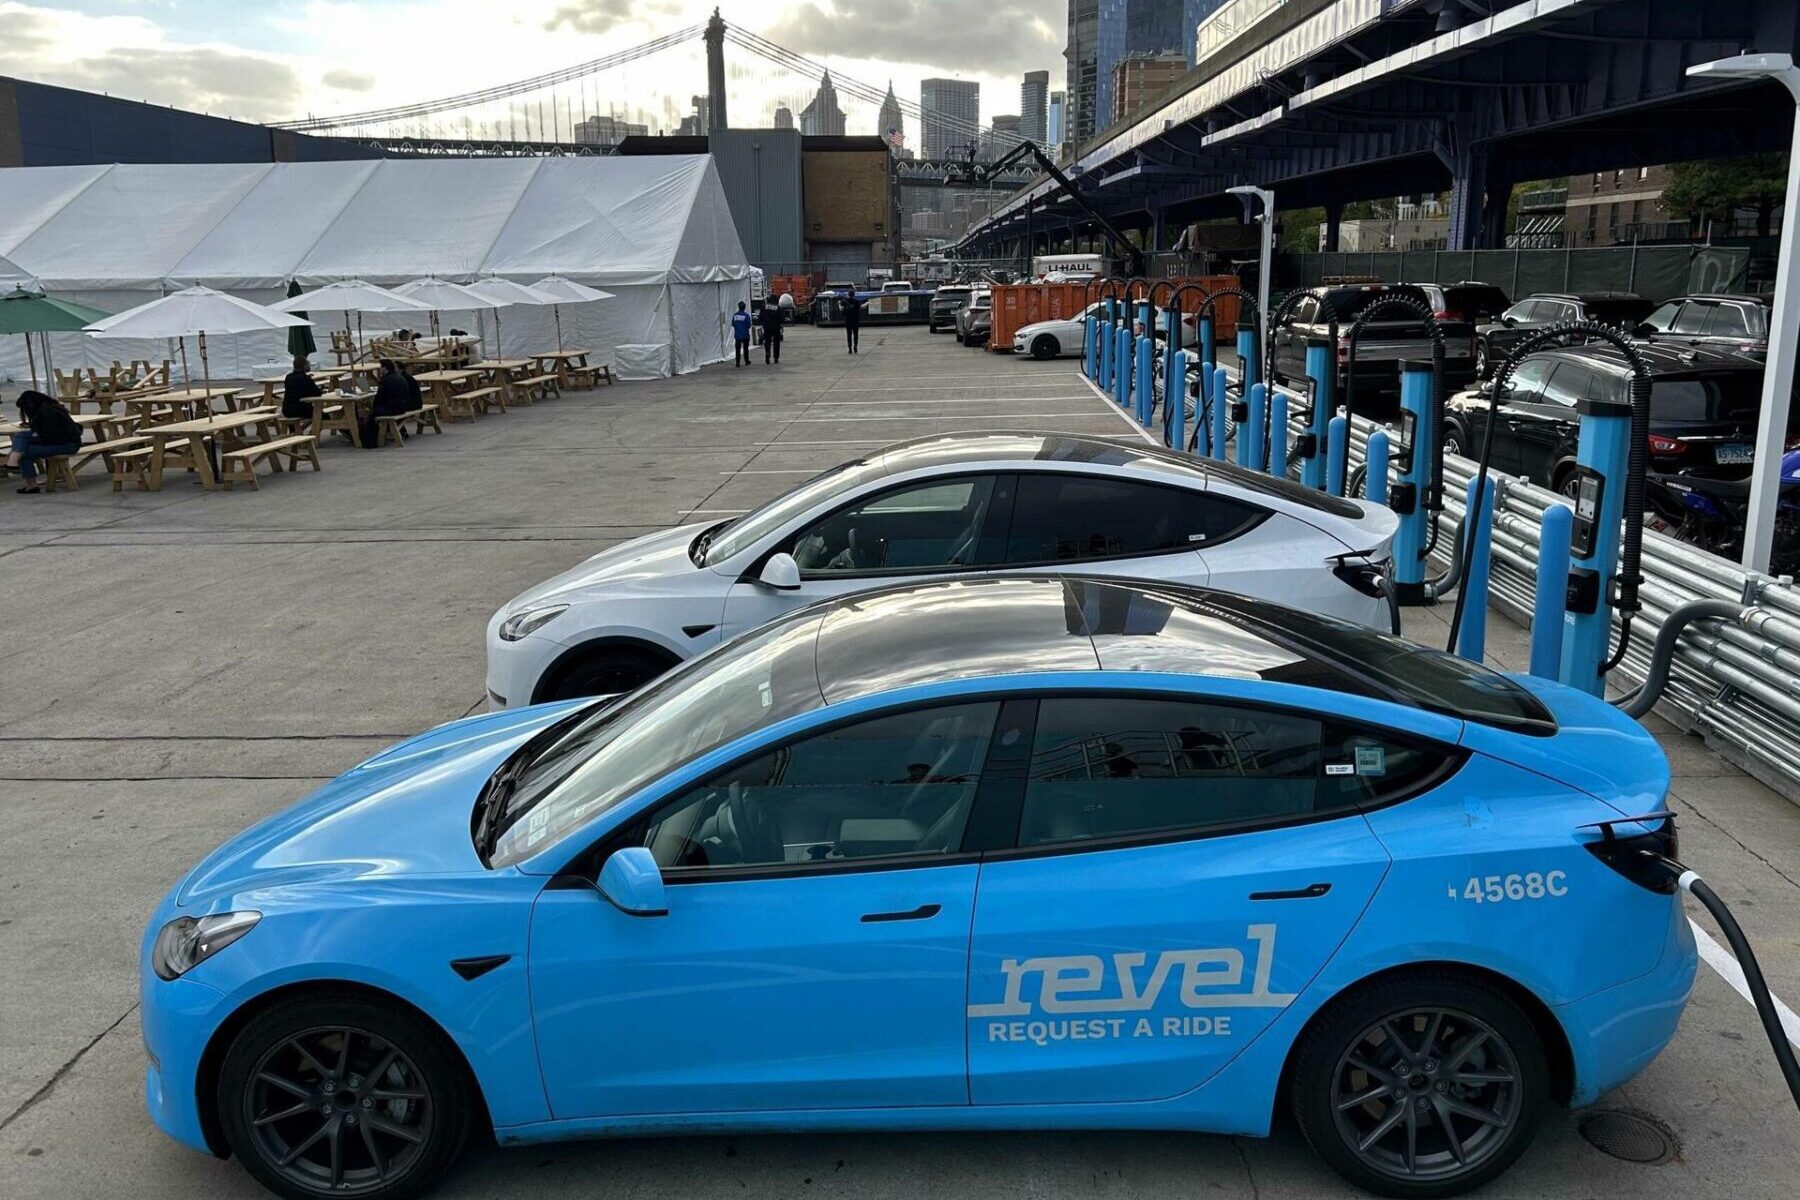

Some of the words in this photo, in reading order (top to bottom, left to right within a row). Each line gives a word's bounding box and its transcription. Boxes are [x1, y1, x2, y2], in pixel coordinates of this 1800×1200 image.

[1048, 263, 1093, 273] U-HAUL
[1463, 870, 1569, 904] 4568C
[967, 923, 1300, 1018] revel
[988, 1019, 1125, 1046] REQUEST
[1133, 1018, 1155, 1038] A
[1162, 1016, 1232, 1038] RIDE
